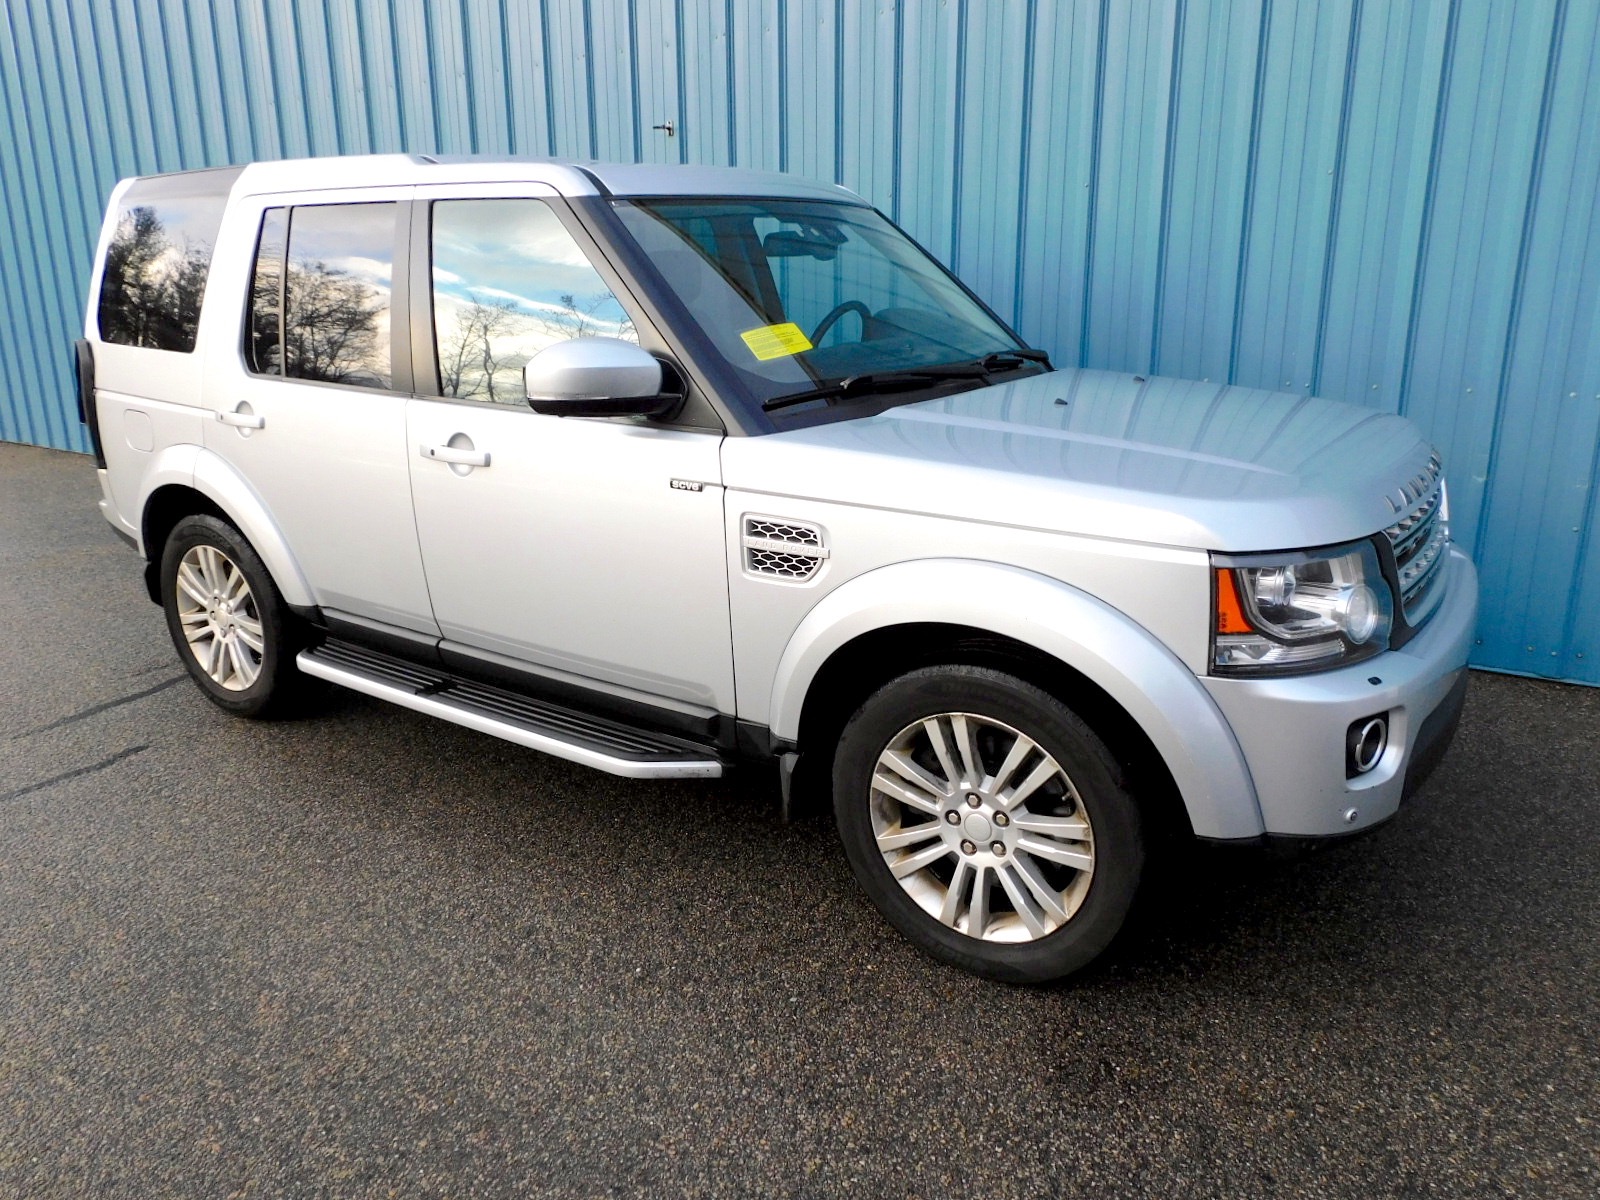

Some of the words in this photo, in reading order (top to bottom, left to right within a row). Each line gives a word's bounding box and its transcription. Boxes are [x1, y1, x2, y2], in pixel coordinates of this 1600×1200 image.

[671, 480, 700, 491] SCV6
[1384, 474, 1430, 514] LAND
[747, 538, 776, 550] LAND
[782, 544, 824, 557] ROVER
